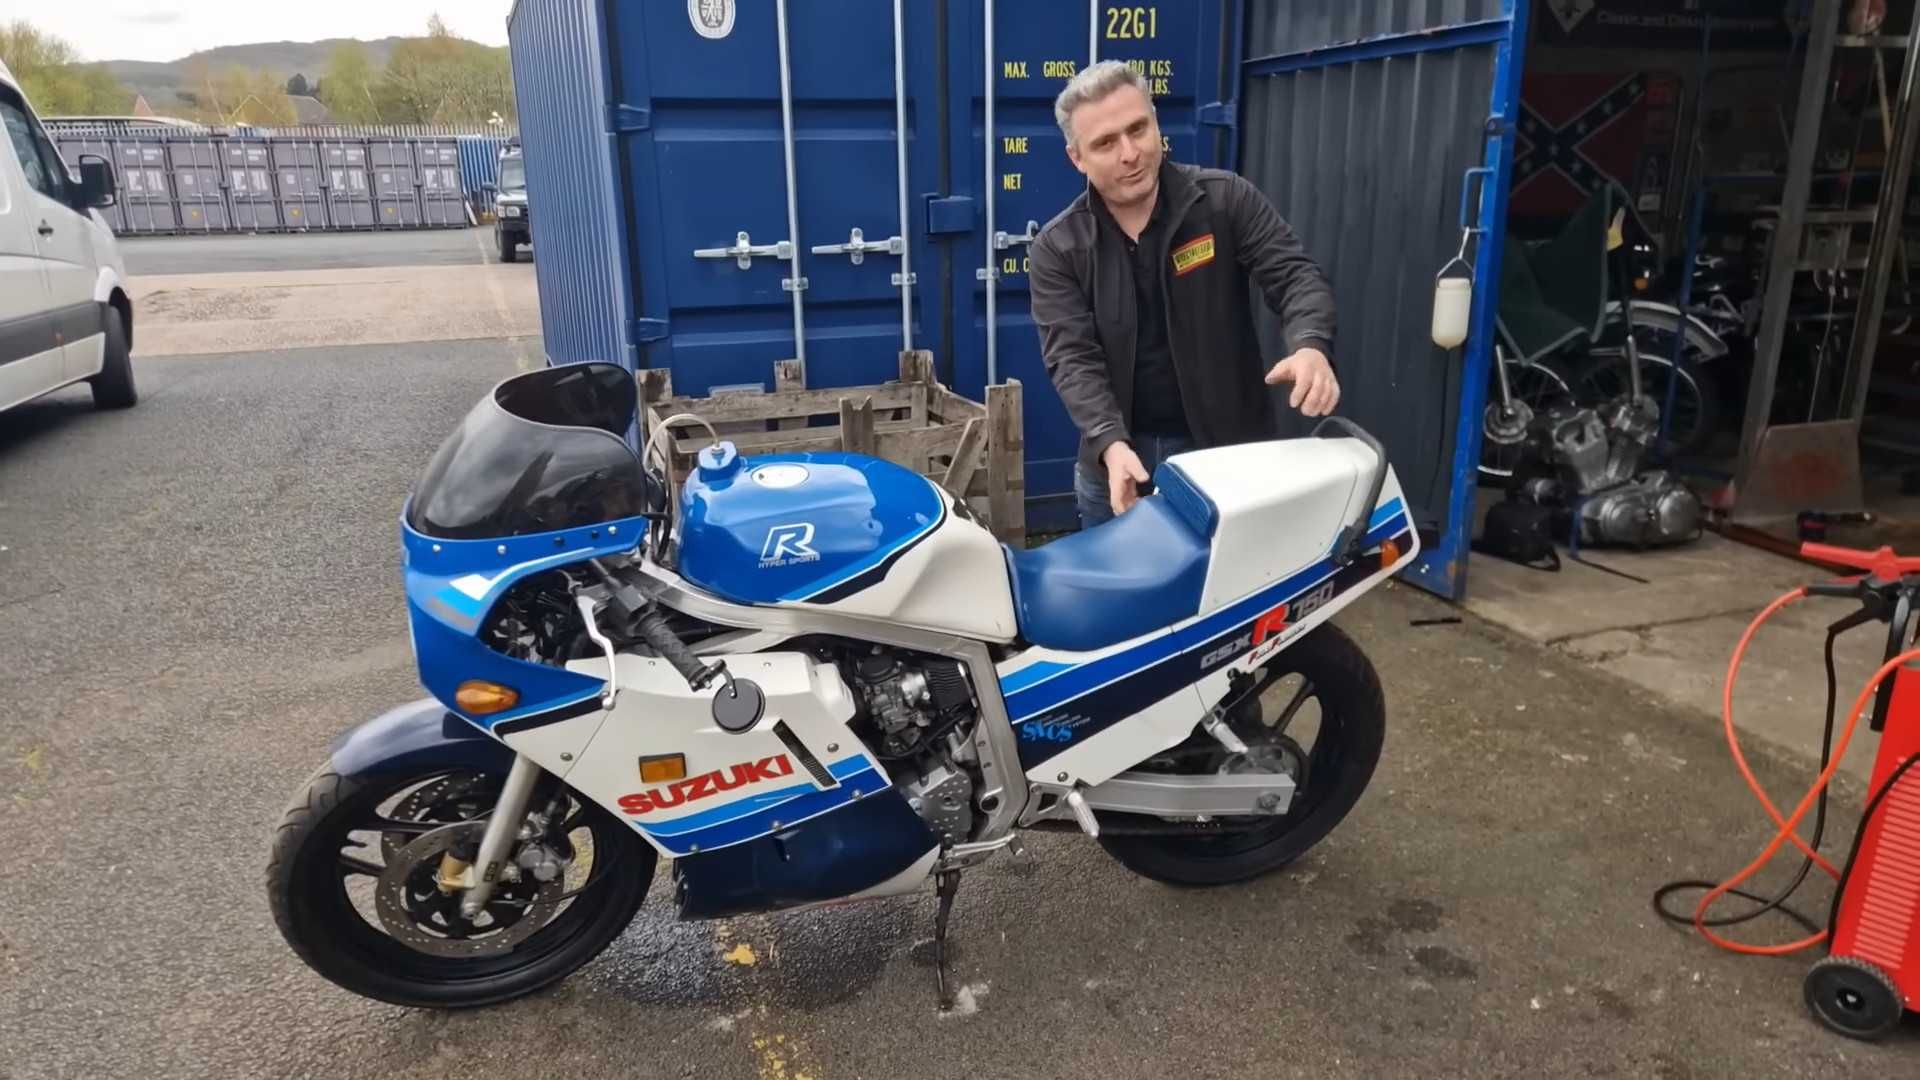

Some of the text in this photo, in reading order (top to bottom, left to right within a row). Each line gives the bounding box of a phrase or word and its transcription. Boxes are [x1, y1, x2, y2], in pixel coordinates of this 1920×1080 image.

[1106, 7, 1156, 39] 22G1
[1004, 61, 1030, 78] MAX.
[1043, 60, 1076, 78] GROSS
[1150, 60, 1174, 76] KGS.
[1003, 137, 1028, 153] TARE
[1003, 174, 1022, 190] NET
[1003, 257, 1019, 273] CU.
[617, 753, 794, 815] SUZUKI
